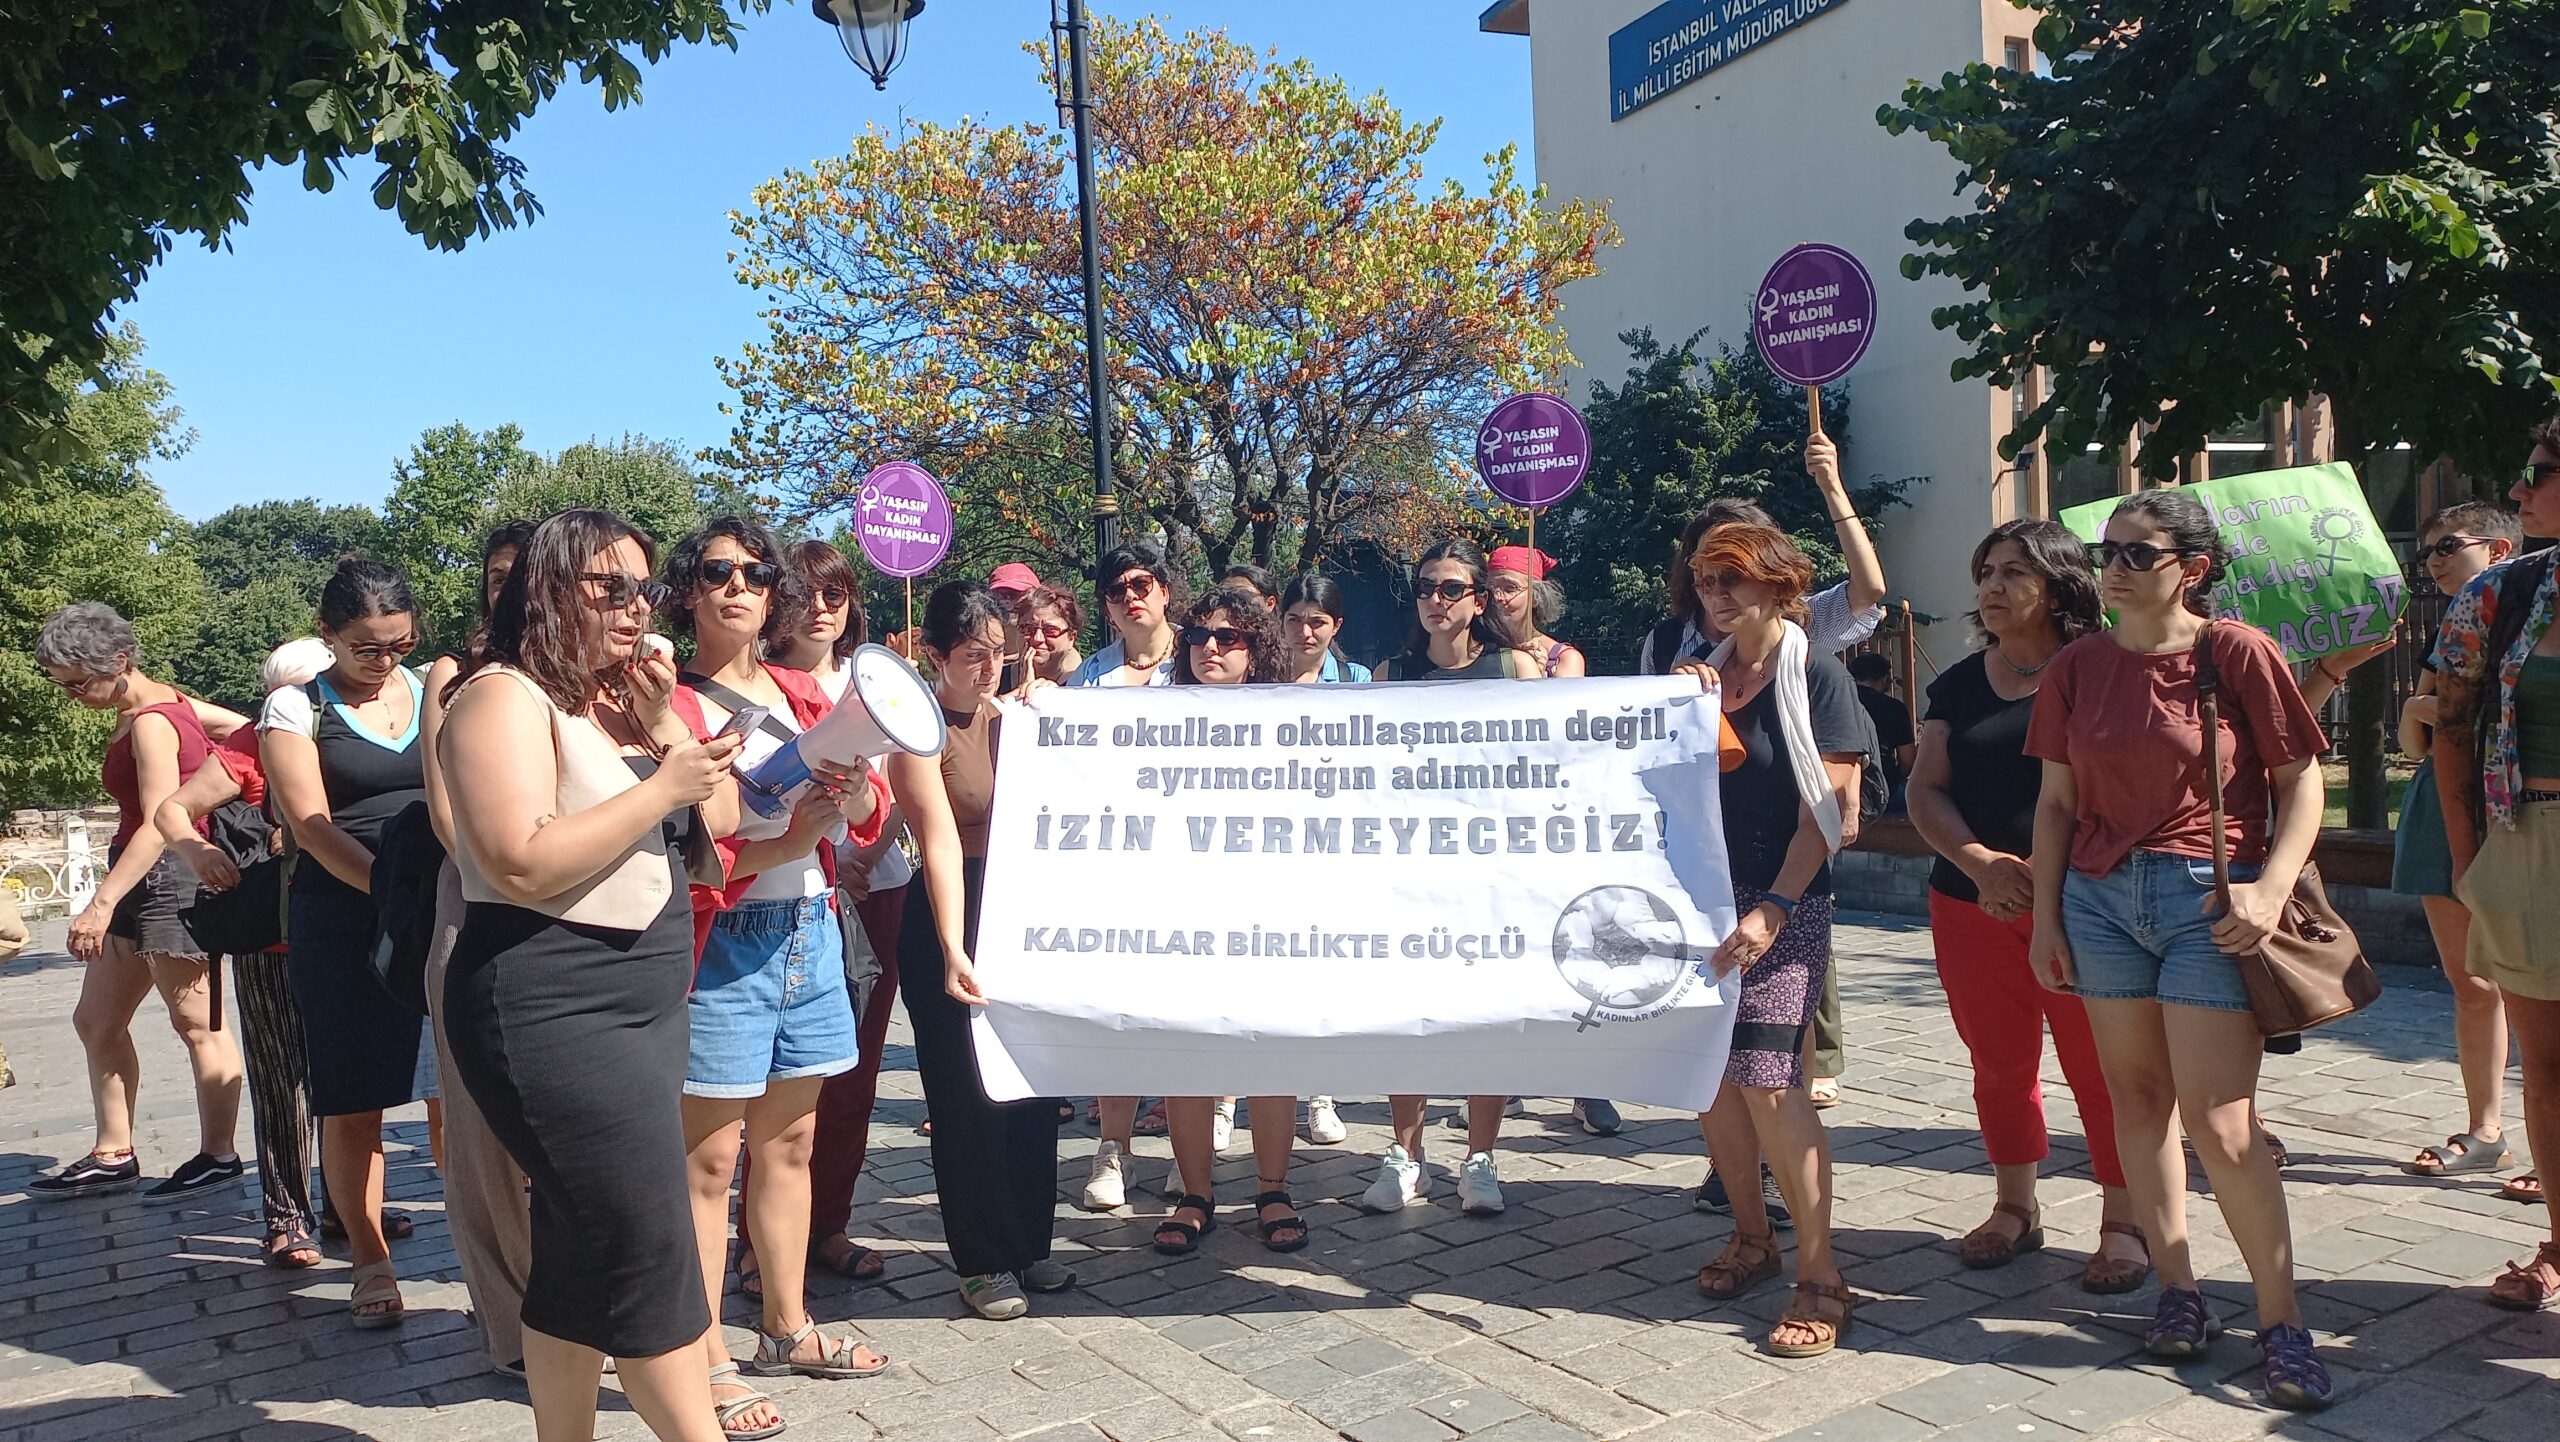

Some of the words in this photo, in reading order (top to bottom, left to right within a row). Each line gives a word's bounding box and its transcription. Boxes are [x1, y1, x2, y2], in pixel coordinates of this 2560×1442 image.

[1648, 11, 1719, 67] İSTANBUL
[1618, 89, 1631, 114] İL
[1634, 64, 1670, 107] MİLLİ
[1673, 40, 1722, 86] EĞİTİM
[1780, 283, 1840, 307] YAŞASIN
[1788, 304, 1834, 324] KADIN
[1768, 318, 1862, 347] DAYANIŞMASI
[1504, 426, 1559, 444] YAŞASIN
[1512, 442, 1554, 457] KADIN
[1491, 455, 1578, 475] DAYANIŞMASI
[881, 494, 928, 513] YAŞASIN
[2203, 494, 2311, 529] ların
[885, 511, 921, 527] KADIN
[864, 523, 940, 545] DAYANIŞMASI
[2229, 530, 2271, 562] de
[2211, 557, 2329, 601] nadığı
[1037, 716, 1098, 747] Kız
[1112, 717, 1262, 747] okulları
[1276, 714, 1550, 752] okullaşmanın
[1565, 705, 1679, 750] değil,
[1136, 756, 1376, 798] ayrımcılığın
[1391, 756, 1570, 790] adımıdır.
[1034, 805, 1155, 851] İZİN
[1186, 803, 1669, 855] VERMEYECEĞİZ!
[1023, 927, 1215, 956] KADINLAR
[1227, 924, 1389, 958] BİRLİKTE
[1400, 926, 1526, 966] GÜÇLÜ
[1596, 1009, 1649, 1023] KADINLAR
